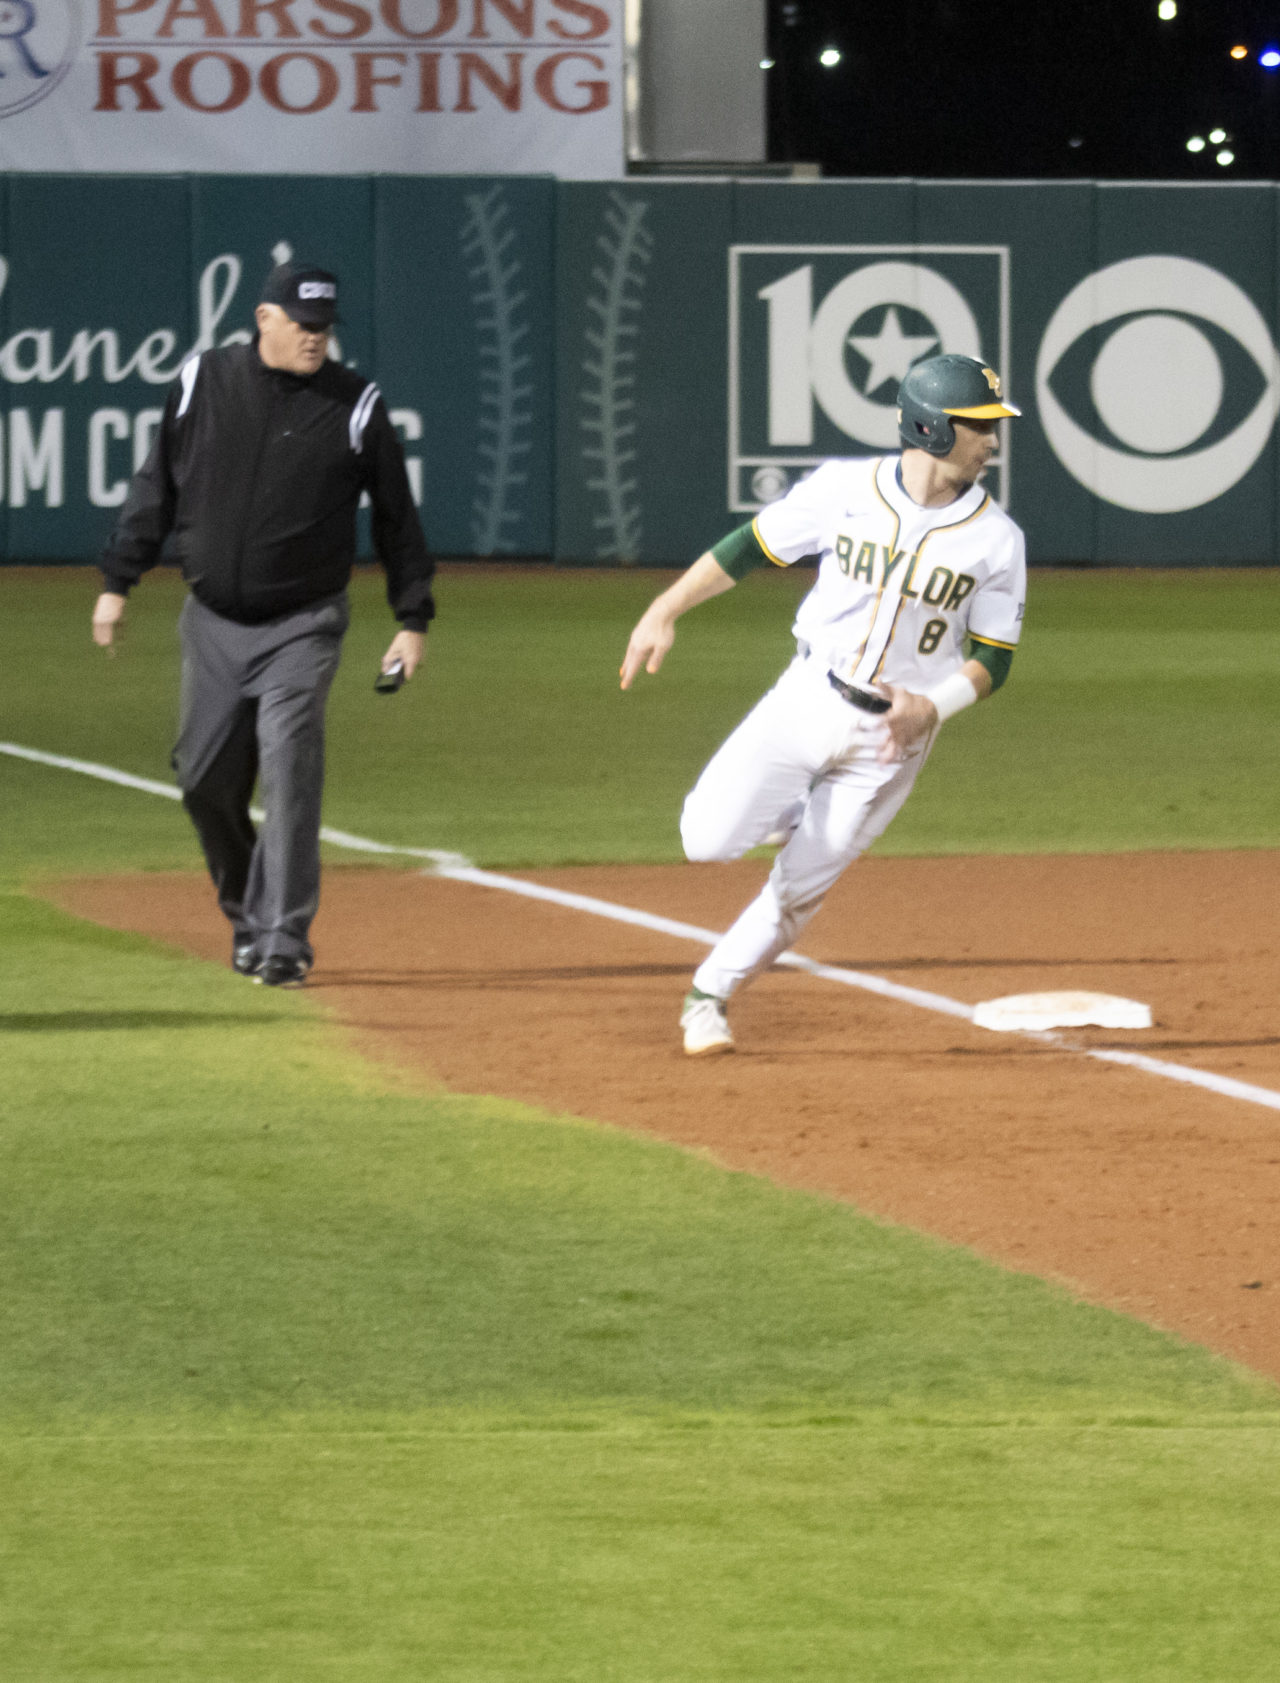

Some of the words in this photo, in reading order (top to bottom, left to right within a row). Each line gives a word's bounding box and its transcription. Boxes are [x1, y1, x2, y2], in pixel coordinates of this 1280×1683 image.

[94, 0, 612, 41] PARSONS
[93, 51, 613, 115] ROOFING
[758, 264, 982, 448] 10
[834, 534, 977, 613] BAYLOR
[917, 618, 949, 656] 8
